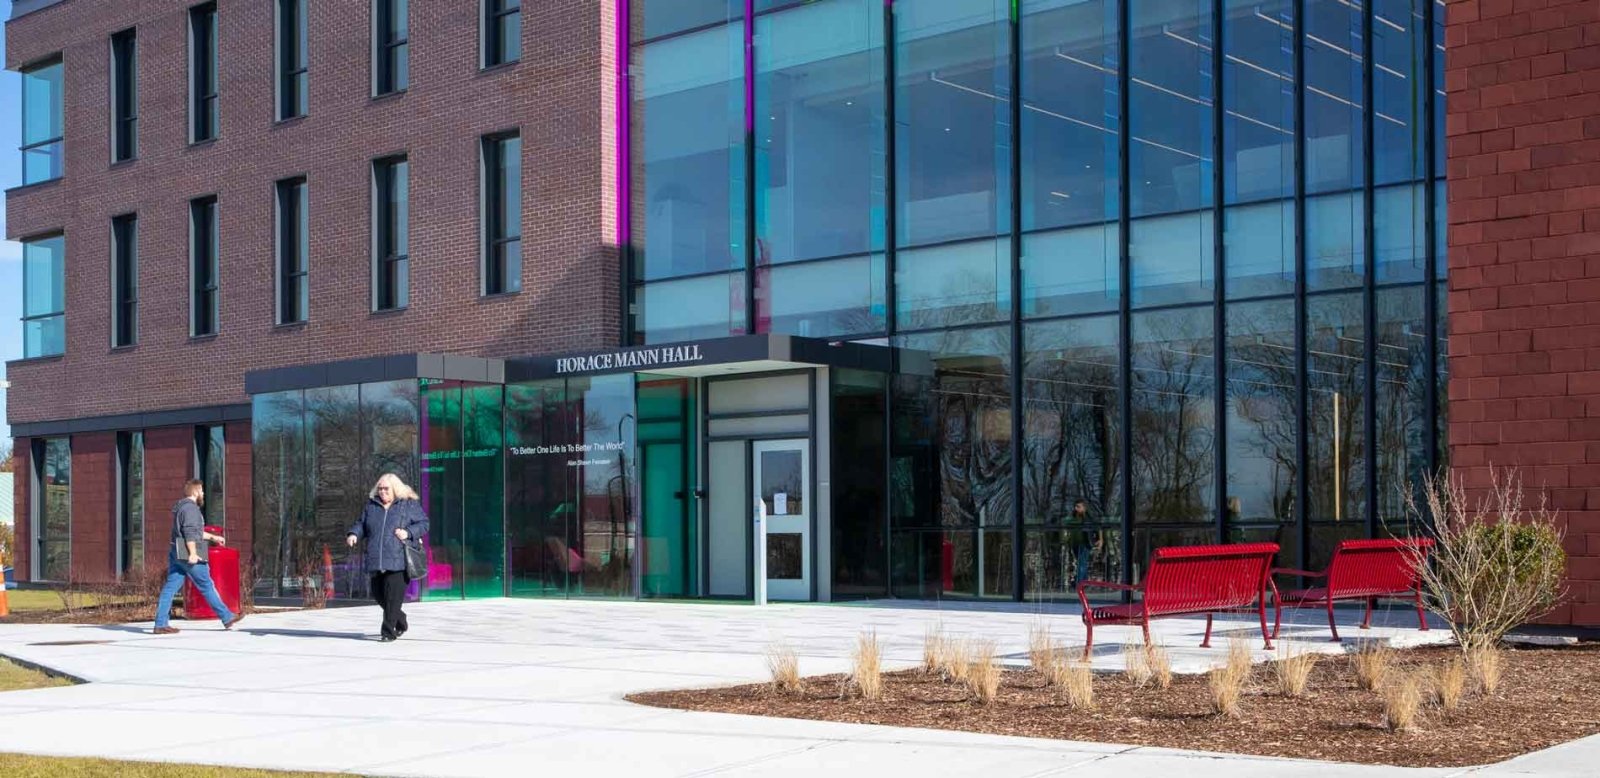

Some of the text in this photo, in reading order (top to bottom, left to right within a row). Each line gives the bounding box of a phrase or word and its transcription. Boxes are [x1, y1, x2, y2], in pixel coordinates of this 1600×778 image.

[556, 344, 703, 374] HORACE MANN HALL
[520, 446, 536, 455] Better
[537, 445, 549, 454] One
[550, 444, 560, 453] Life
[561, 444, 567, 453] Is
[568, 443, 575, 452] To
[575, 442, 592, 452] Better
[593, 442, 605, 451] The
